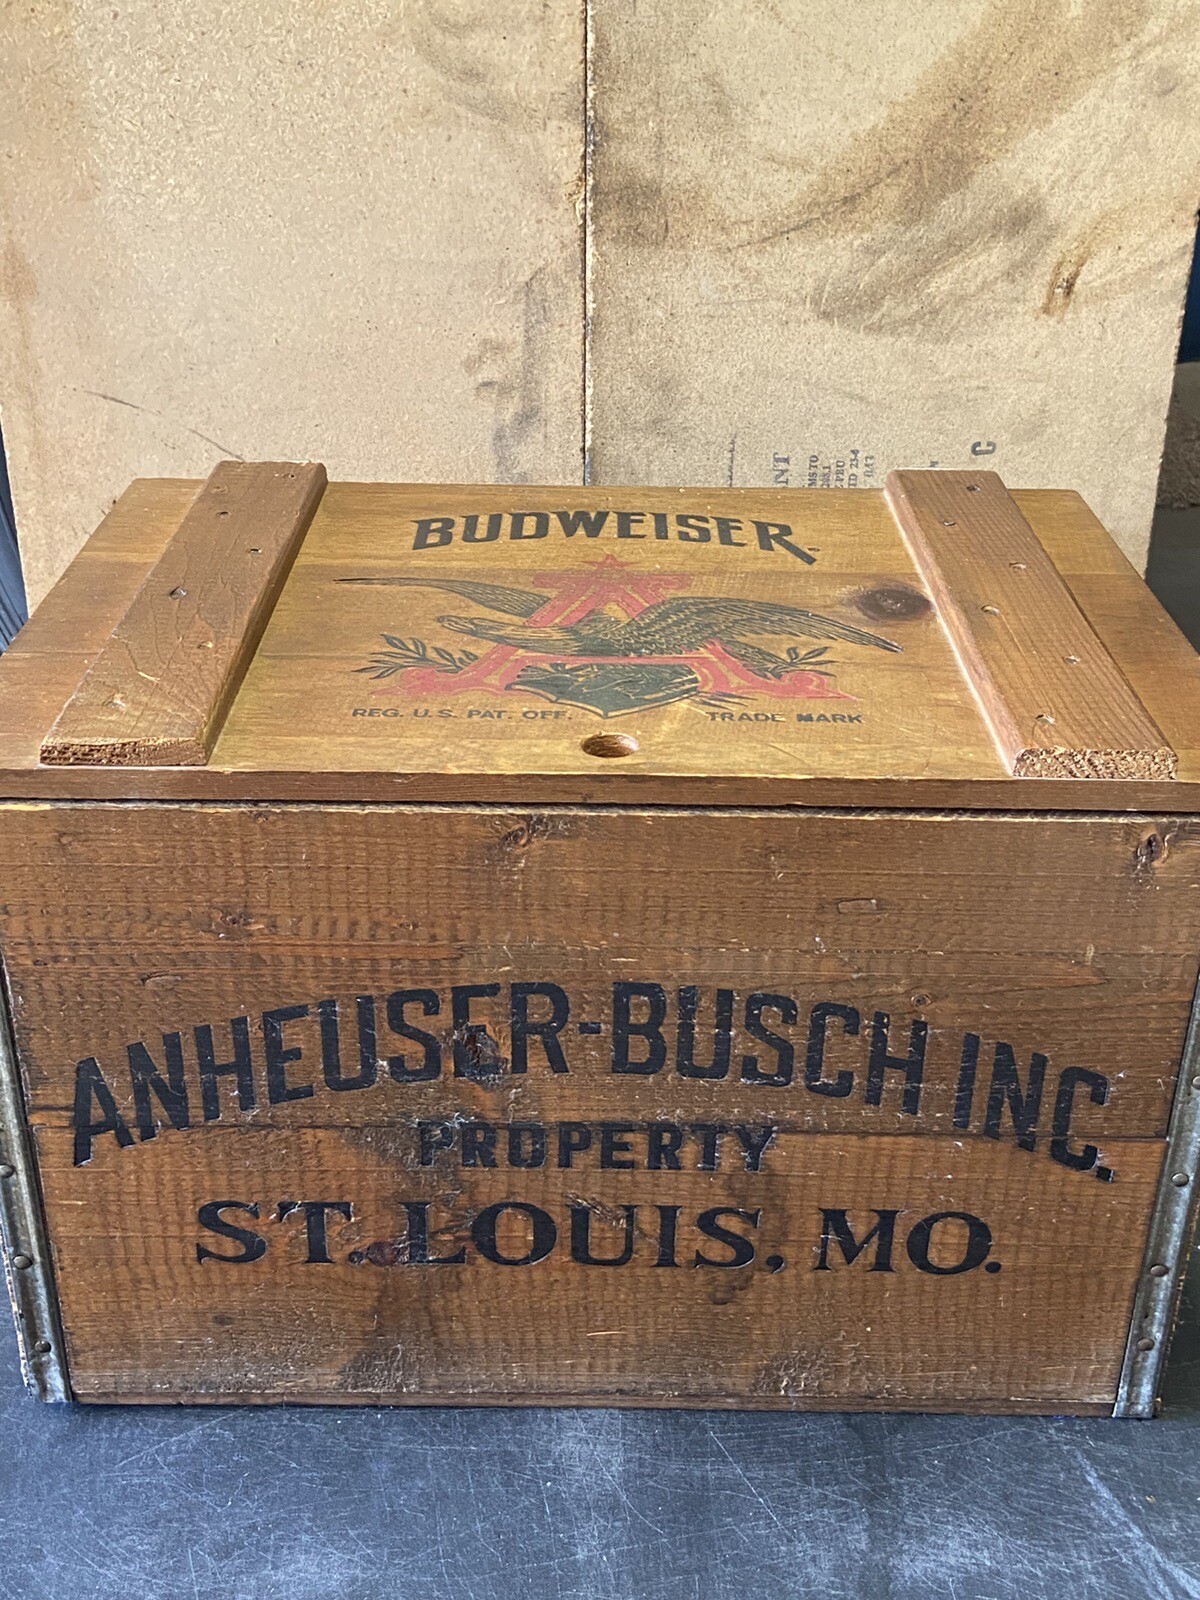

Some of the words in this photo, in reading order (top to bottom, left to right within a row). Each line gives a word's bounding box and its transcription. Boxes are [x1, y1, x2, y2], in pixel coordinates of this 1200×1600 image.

[808, 454, 819, 470] TO
[971, 441, 997, 456] C
[410, 510, 817, 566] BUDWEISER
[352, 708, 403, 718] REG.
[467, 709, 512, 719] PAT.
[521, 710, 573, 720] OFF.
[705, 711, 786, 722] TRADE
[796, 713, 863, 723] MARK
[73, 981, 929, 1167] ANHEUSER-BUSCH
[952, 1032, 1115, 1183] INC.
[417, 1120, 779, 1172] PROPERTY
[812, 1208, 1002, 1275] MO.
